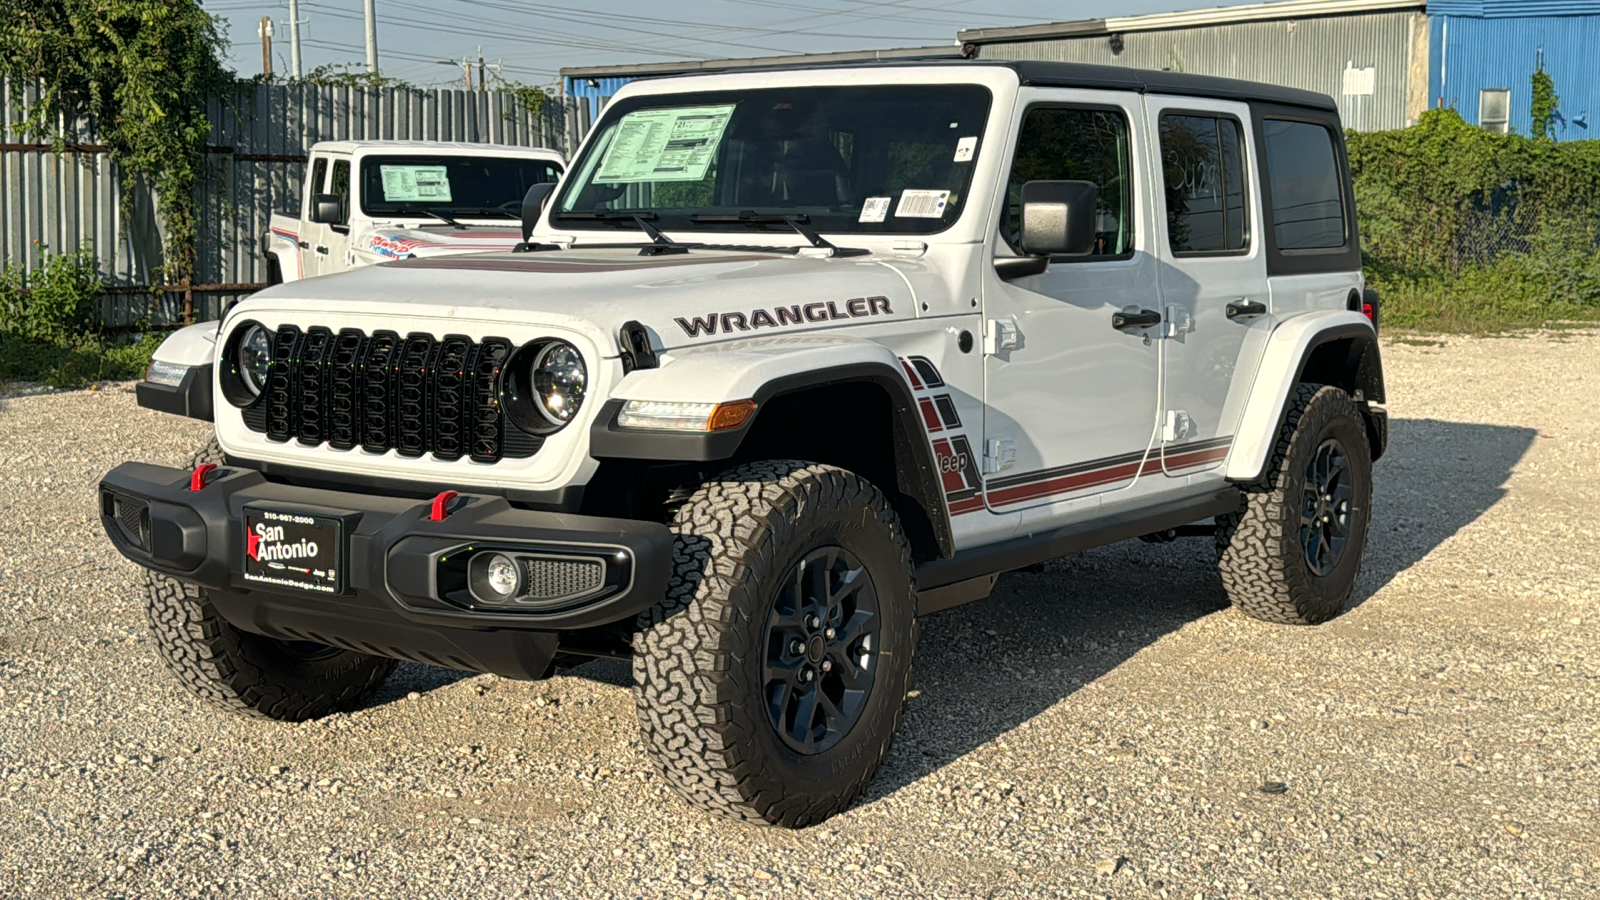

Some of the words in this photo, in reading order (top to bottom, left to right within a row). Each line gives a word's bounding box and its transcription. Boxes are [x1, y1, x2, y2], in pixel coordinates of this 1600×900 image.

[673, 295, 894, 338] WRANGLER
[937, 452, 967, 474] Jeep
[255, 522, 284, 543] San
[257, 537, 318, 562] Antonio
[244, 572, 334, 593] SanAntonioDodge.com
